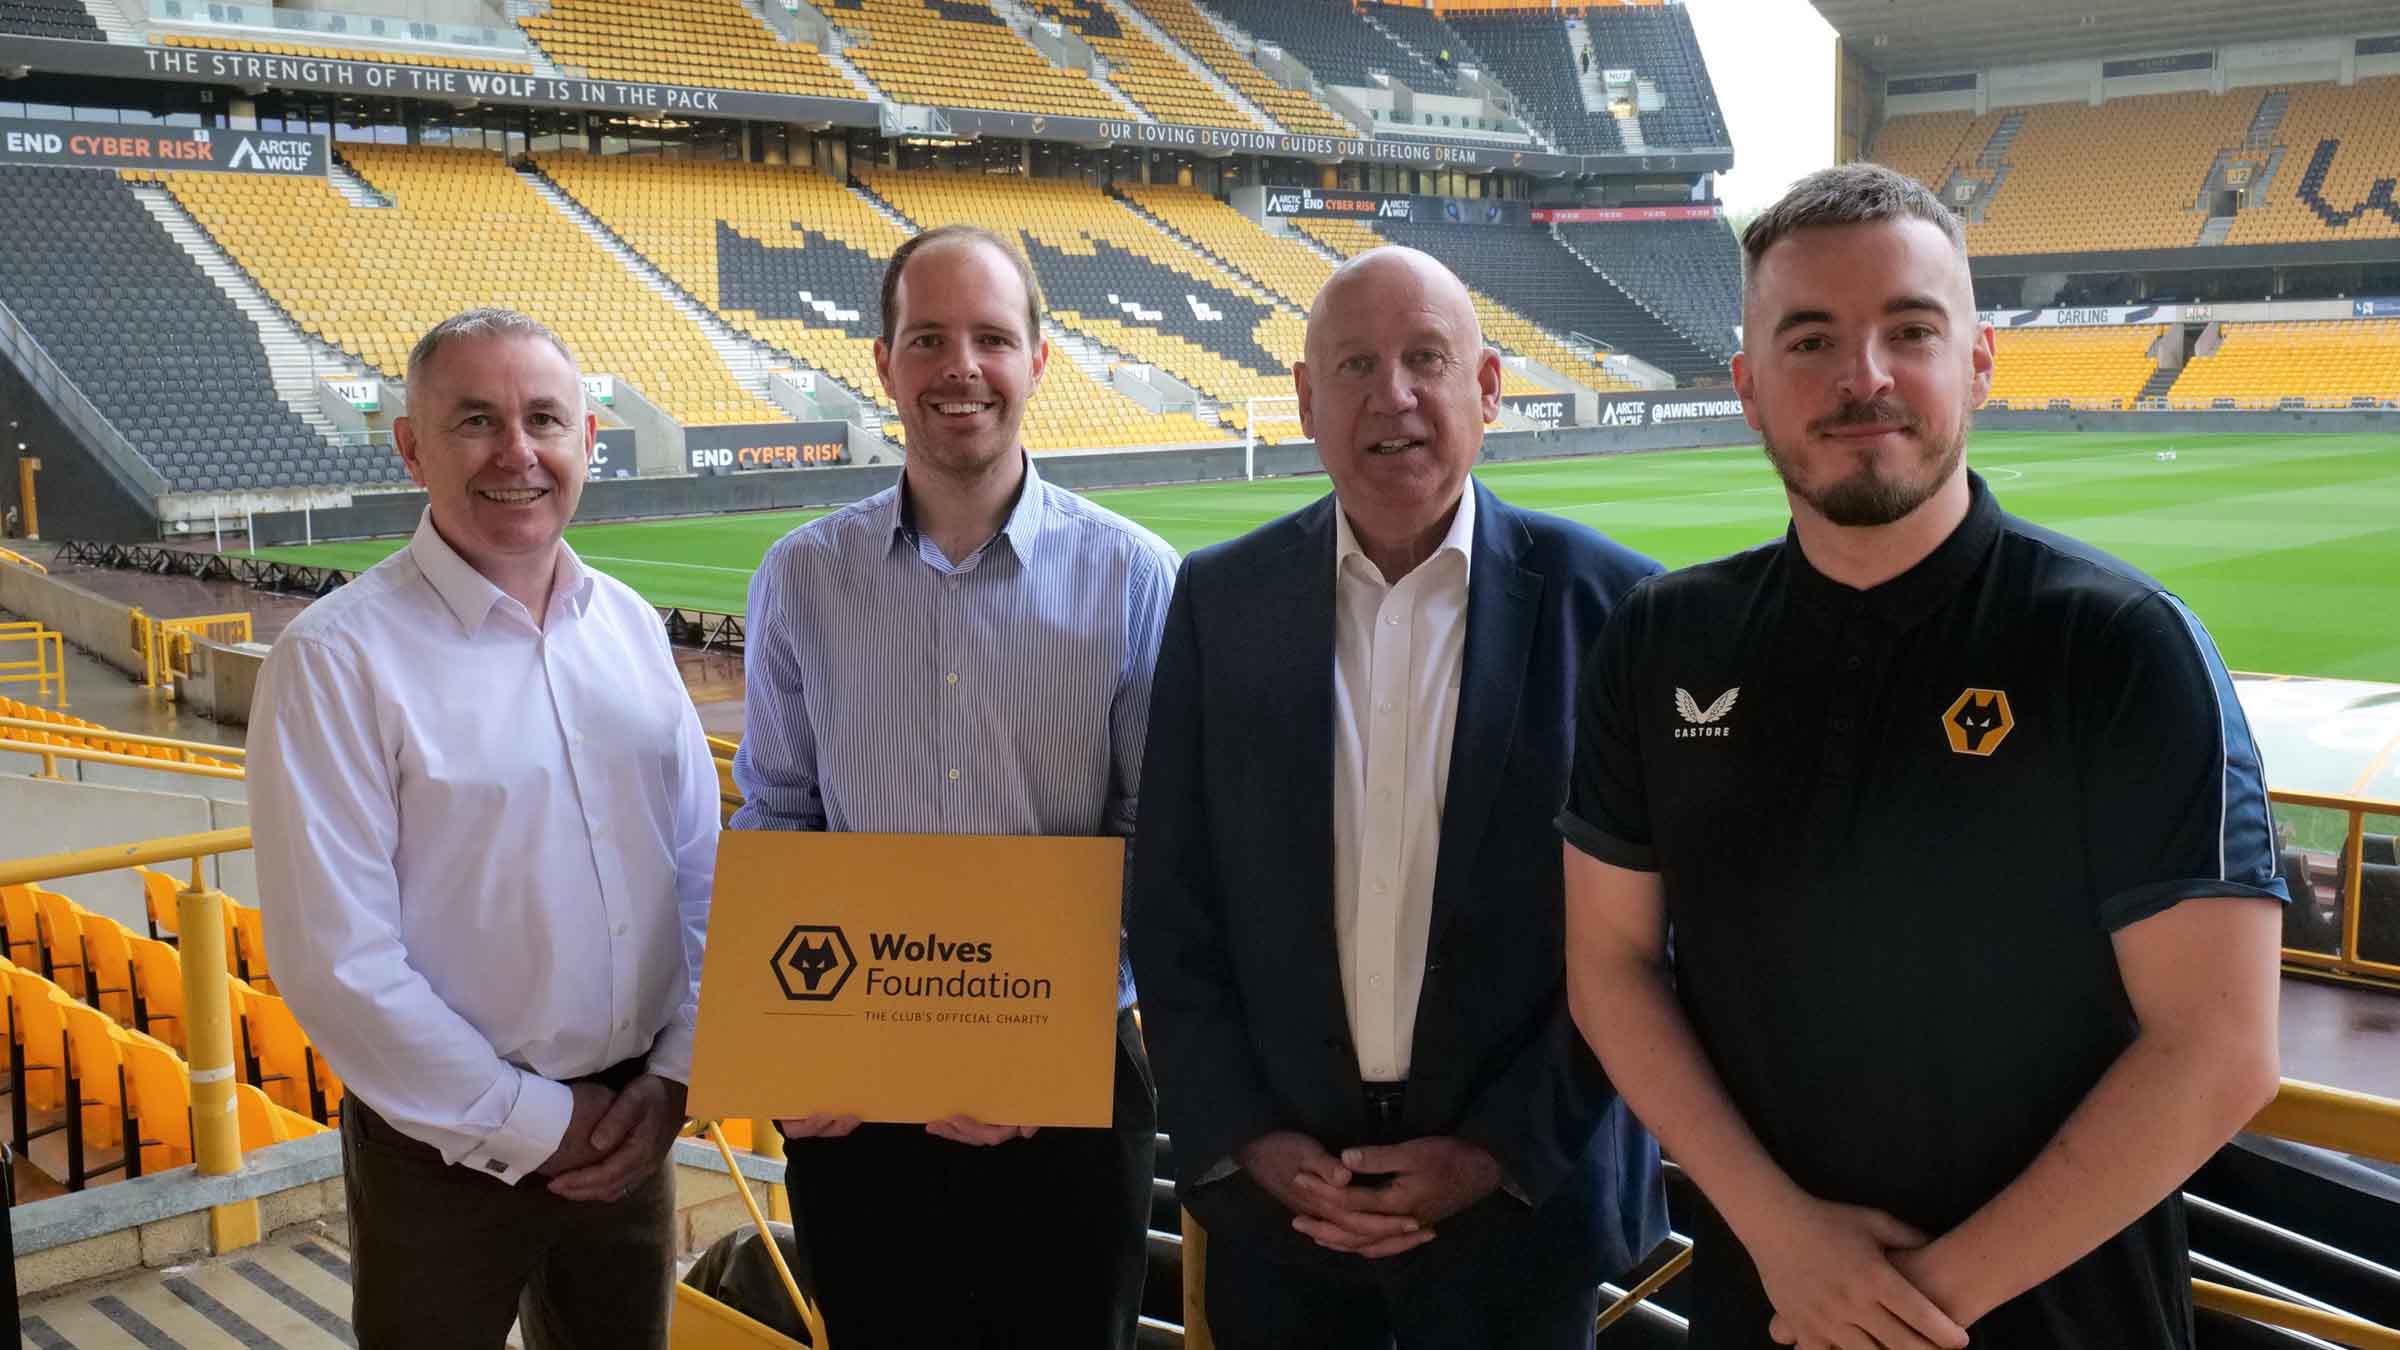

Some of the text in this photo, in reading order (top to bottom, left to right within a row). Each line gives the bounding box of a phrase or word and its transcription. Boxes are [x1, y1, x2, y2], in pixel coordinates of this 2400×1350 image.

[144, 50, 719, 110] THE STRENGTH OF THE WOLF IS IN THE PACK
[7, 131, 214, 161] END CYBER RISK
[258, 139, 312, 156] ARCTIC
[1099, 123, 1476, 163] OUR LOVING DEVOTION GUIDES OUR LIFELONG DREAM
[265, 154, 308, 171] WOLF
[1304, 199, 1376, 212] END CYBER RISK
[2057, 309, 2108, 323] CARLING
[1525, 402, 1563, 418] ARCTIC
[1615, 401, 1645, 415] ARCTIC
[1651, 400, 1743, 422] @AWNETWORKS
[692, 448, 733, 467] END
[803, 443, 843, 462] RISK
[1674, 727, 1730, 738] CASTORE
[870, 933, 992, 963] Wolves
[865, 967, 1051, 999] Foundation
[864, 1010, 1049, 1025] THE CLUB'S OFFICIAL CHARITY
